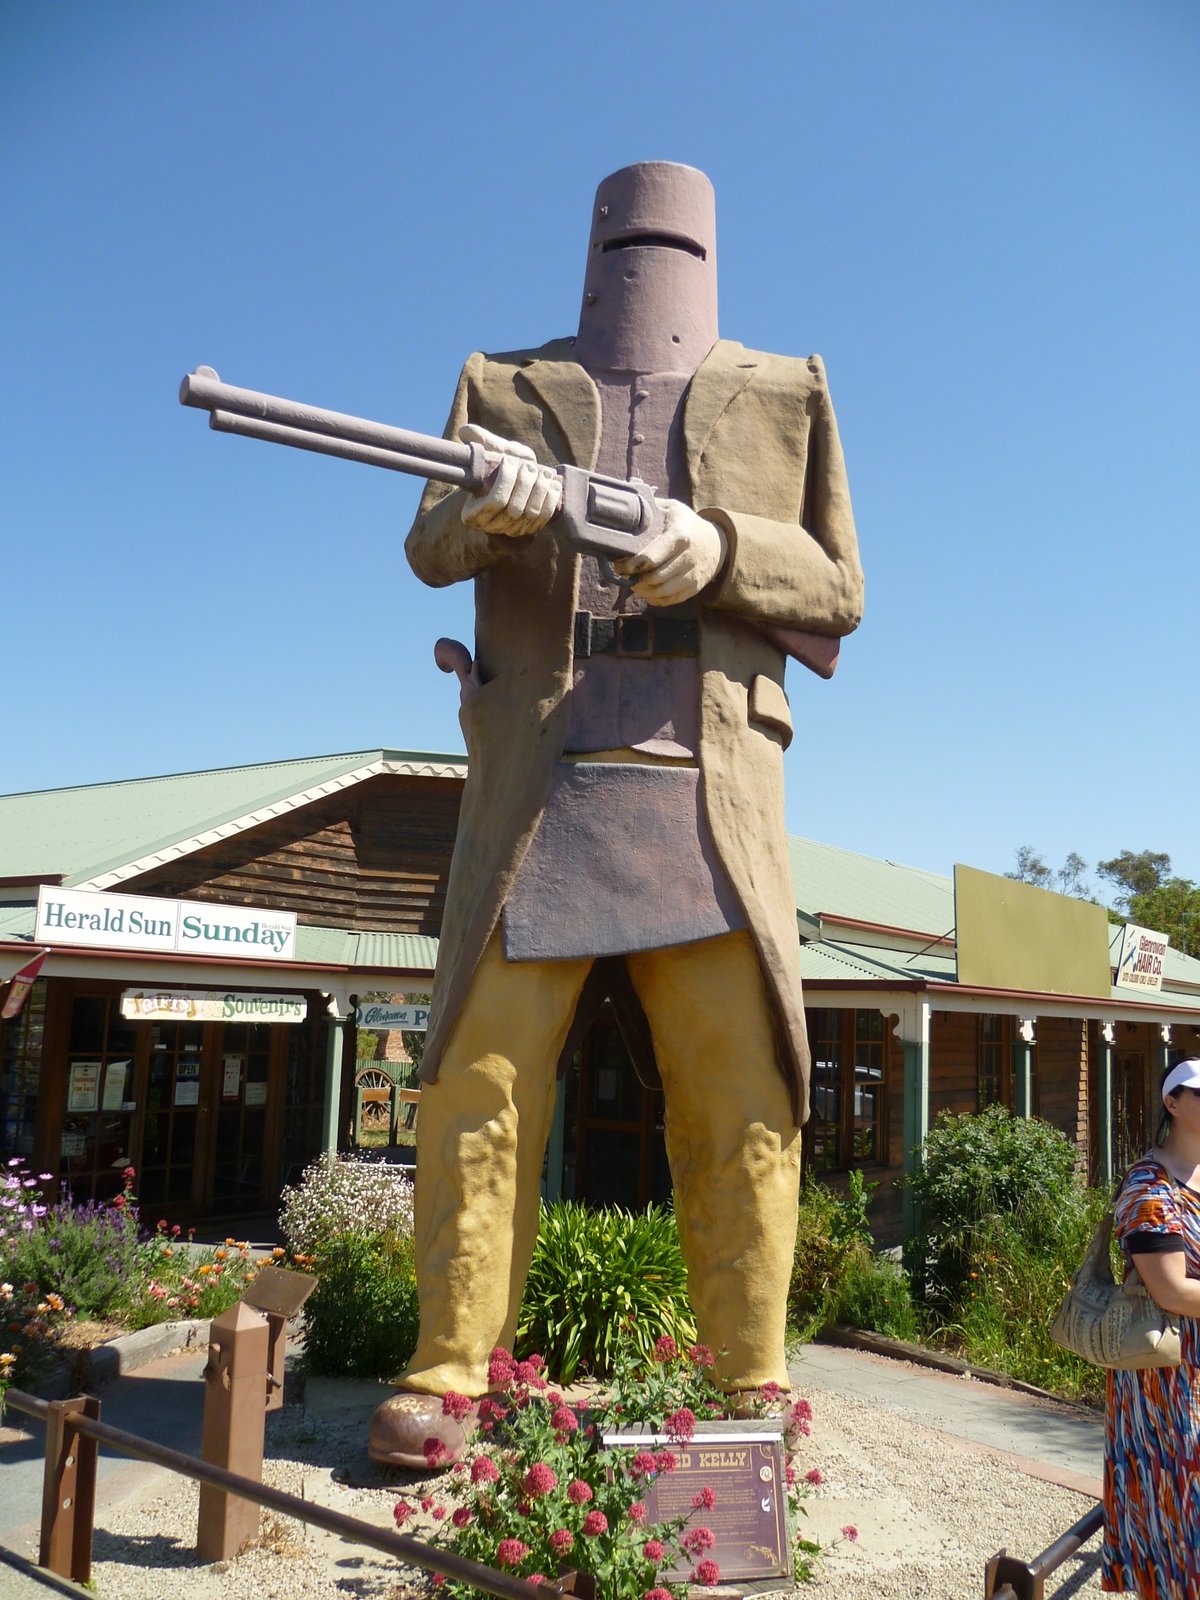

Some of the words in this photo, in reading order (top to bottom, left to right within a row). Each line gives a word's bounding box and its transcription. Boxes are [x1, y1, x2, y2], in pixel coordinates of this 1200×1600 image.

[44, 902, 124, 932] Herald
[129, 911, 172, 936] Sun
[182, 915, 291, 953] Sunday
[1136, 952, 1153, 974] HAIR
[222, 994, 301, 1018] Souvenirs
[178, 1064, 196, 1075] OPEN
[699, 1452, 747, 1468] KELLY
